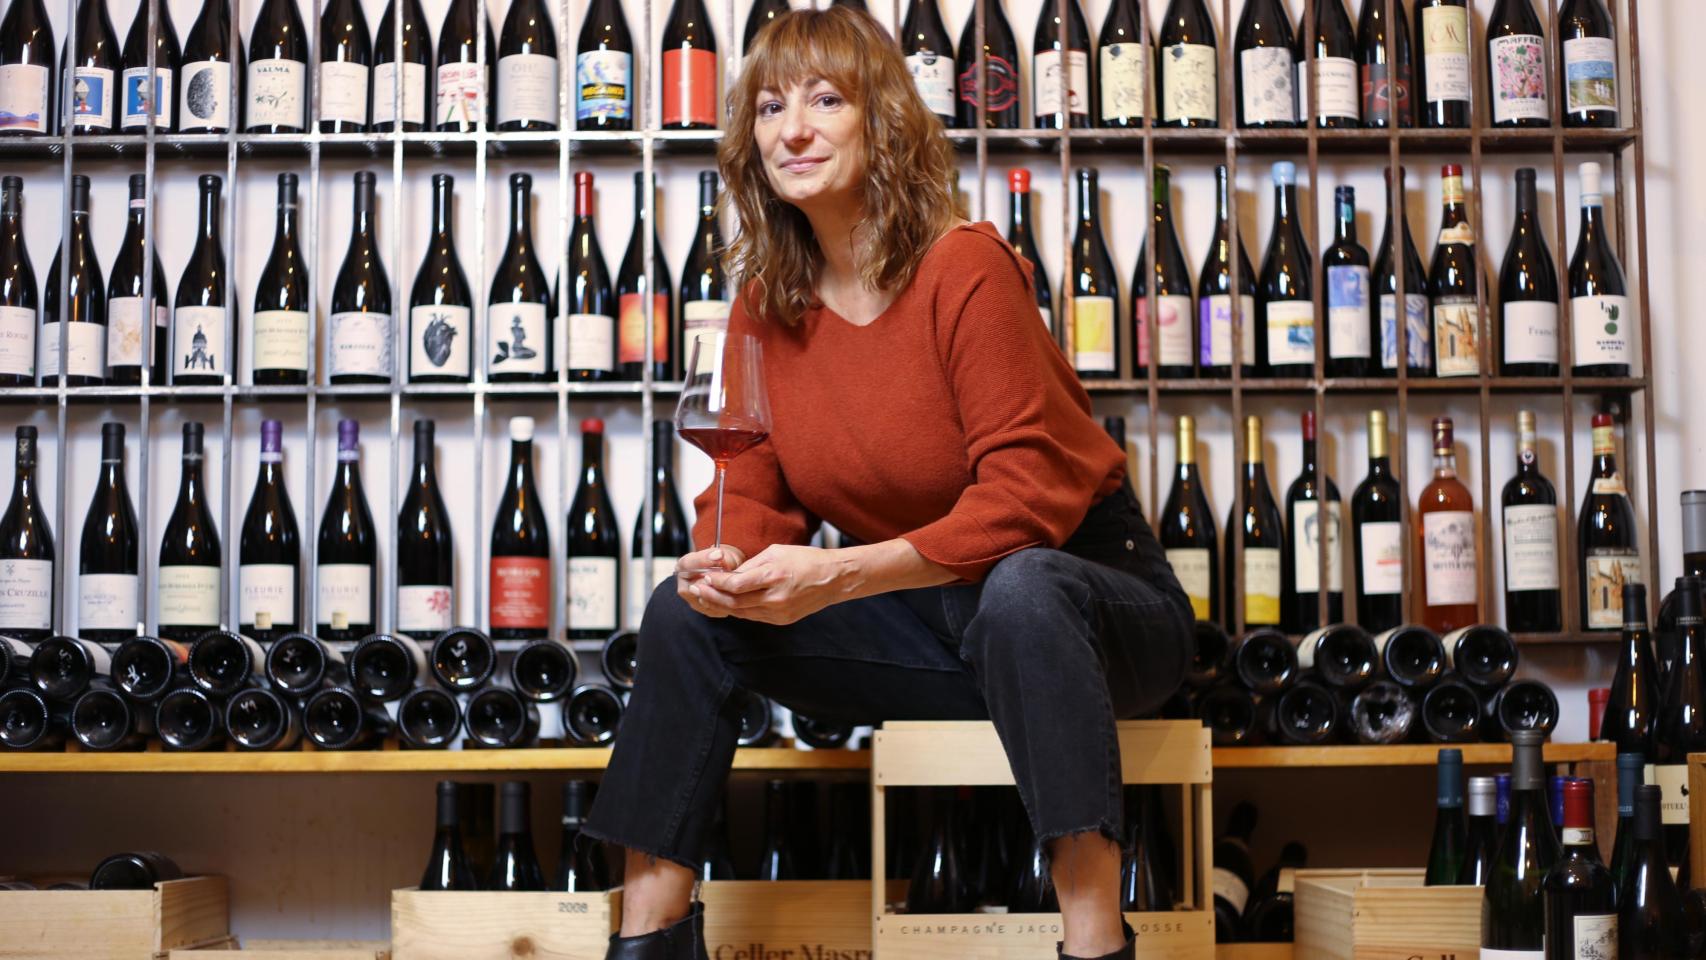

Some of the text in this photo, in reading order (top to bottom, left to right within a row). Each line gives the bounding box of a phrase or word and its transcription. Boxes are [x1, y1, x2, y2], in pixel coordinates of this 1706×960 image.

[245, 585, 284, 593] FLEURIE
[901, 923, 1184, 935] CHAMPAGNE JACQ OSSE
[715, 943, 794, 960] Celler
